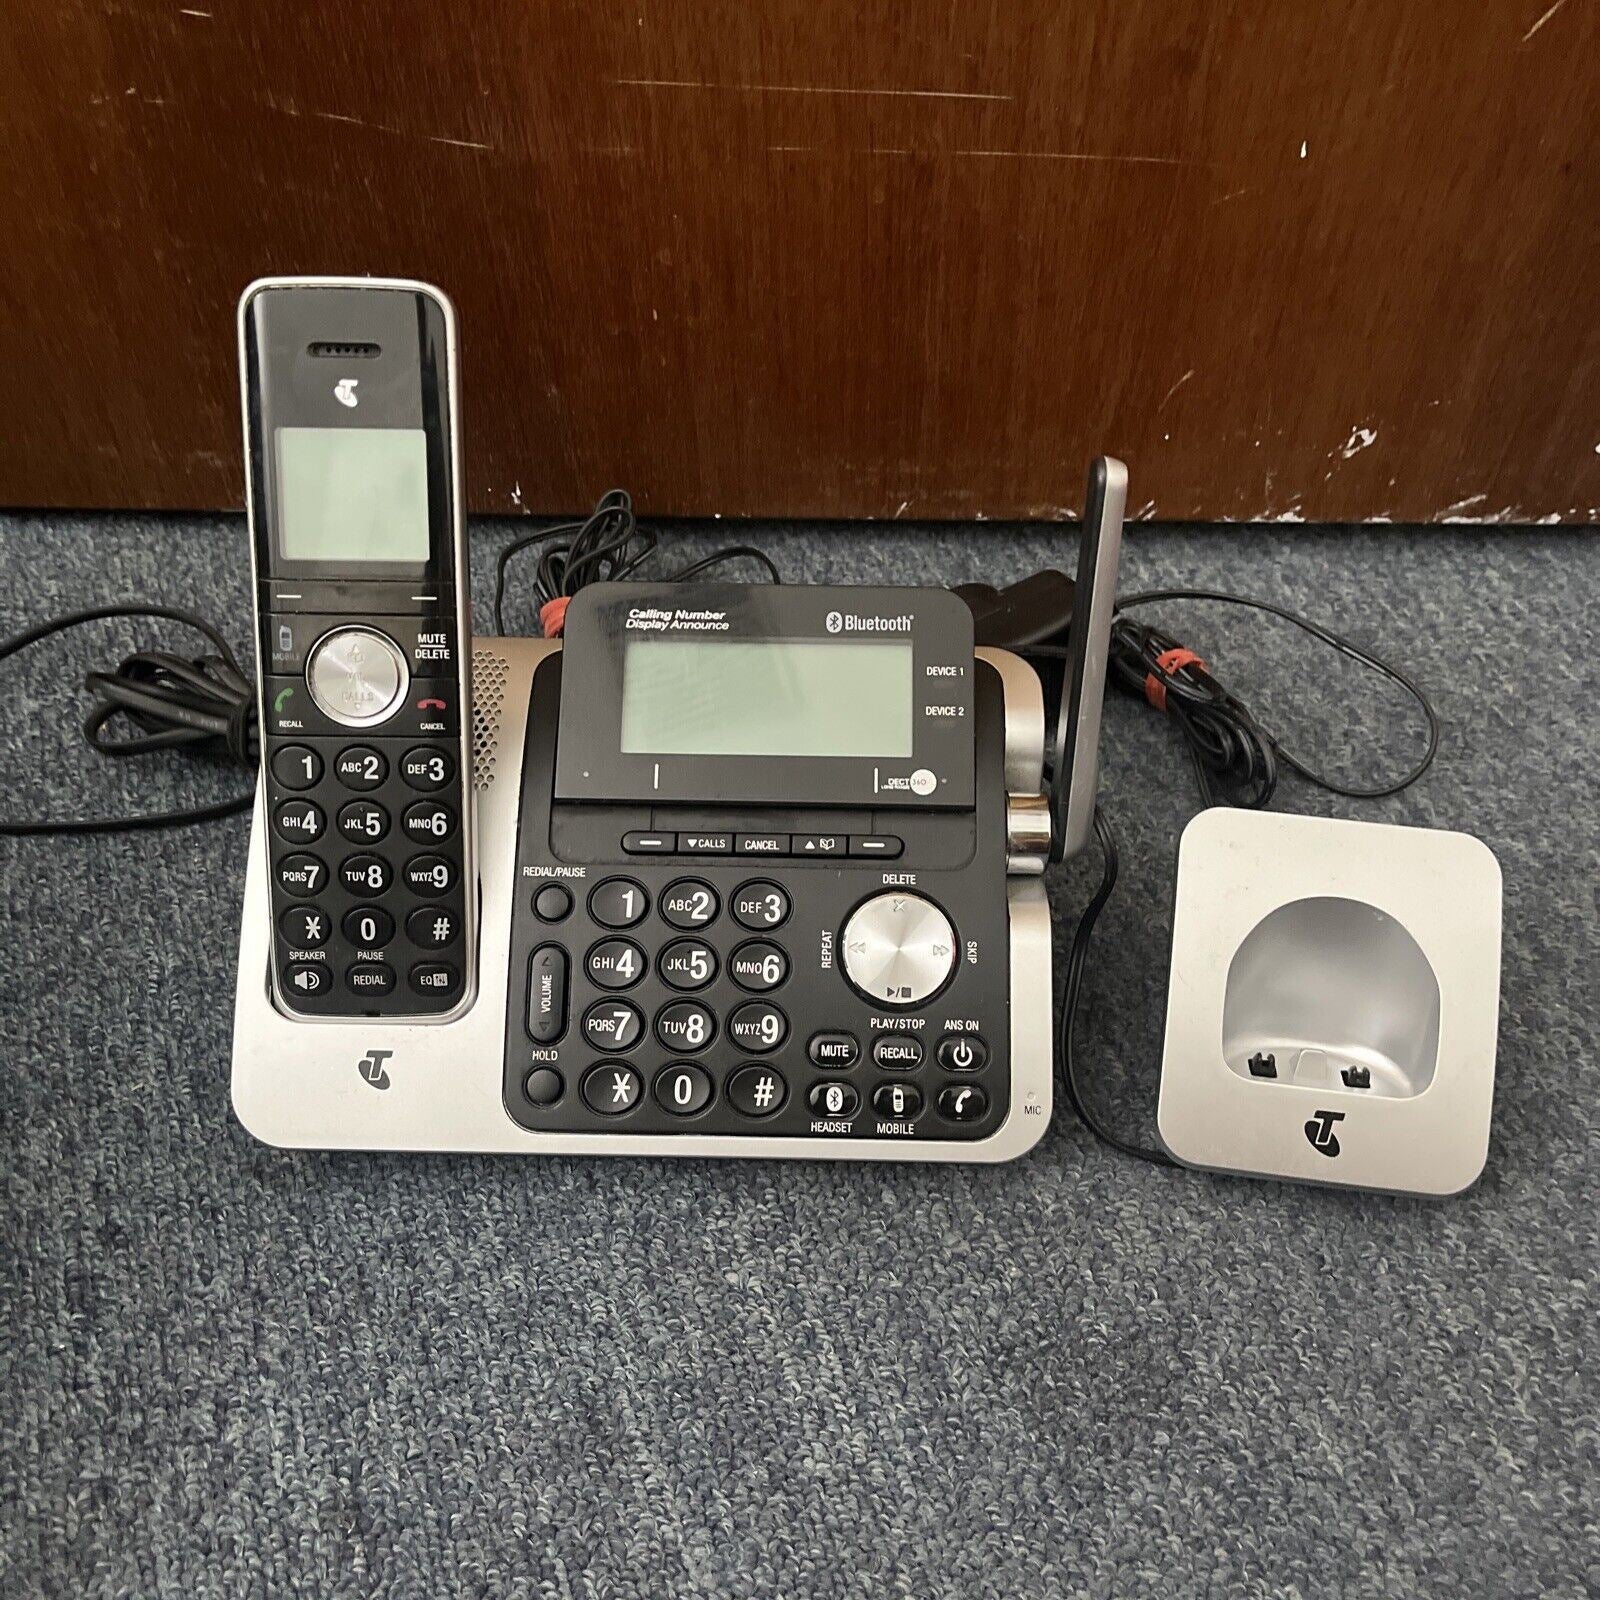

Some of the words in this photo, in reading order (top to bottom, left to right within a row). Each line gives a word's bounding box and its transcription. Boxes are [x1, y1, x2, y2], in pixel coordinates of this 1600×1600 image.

[629, 608, 673, 621] Calling
[674, 609, 726, 620] Number
[625, 618, 669, 631] Display
[670, 619, 730, 630] Announce
[417, 633, 446, 644] MUTE
[415, 649, 450, 659] DELETE
[926, 666, 957, 676] DEVICE
[959, 667, 964, 676] 1
[925, 706, 956, 716] DEVICE
[958, 707, 964, 716] 2
[279, 720, 303, 728] RECALL
[420, 722, 446, 730] CANCEL
[301, 756, 313, 779] 1
[887, 777, 910, 786] DECT
[698, 839, 725, 848] CALLS
[744, 840, 780, 850] CANCEL
[523, 867, 586, 877] REDIAL/PAUSE
[882, 874, 916, 885] DELETE
[621, 890, 634, 918] 1
[360, 918, 375, 941] 0
[821, 930, 832, 969] REPEAT
[967, 941, 977, 964] SKIP
[289, 951, 326, 960] SPEAKER
[357, 951, 384, 960] PAUSE
[353, 974, 386, 985] REDIAL
[420, 975, 432, 986] EQ
[541, 974, 552, 1013] VOLUME
[870, 1018, 926, 1030] PLAY/STOP
[944, 1020, 963, 1031] ANS
[965, 1021, 979, 1031] ON
[532, 1050, 558, 1061] HOLD
[820, 1045, 849, 1057] MUTE
[880, 1048, 917, 1060] RECALL
[674, 1075, 692, 1104] 0
[1023, 1105, 1041, 1115] MIC
[810, 1122, 852, 1133] HEADSET
[876, 1123, 915, 1135] MOBILE
